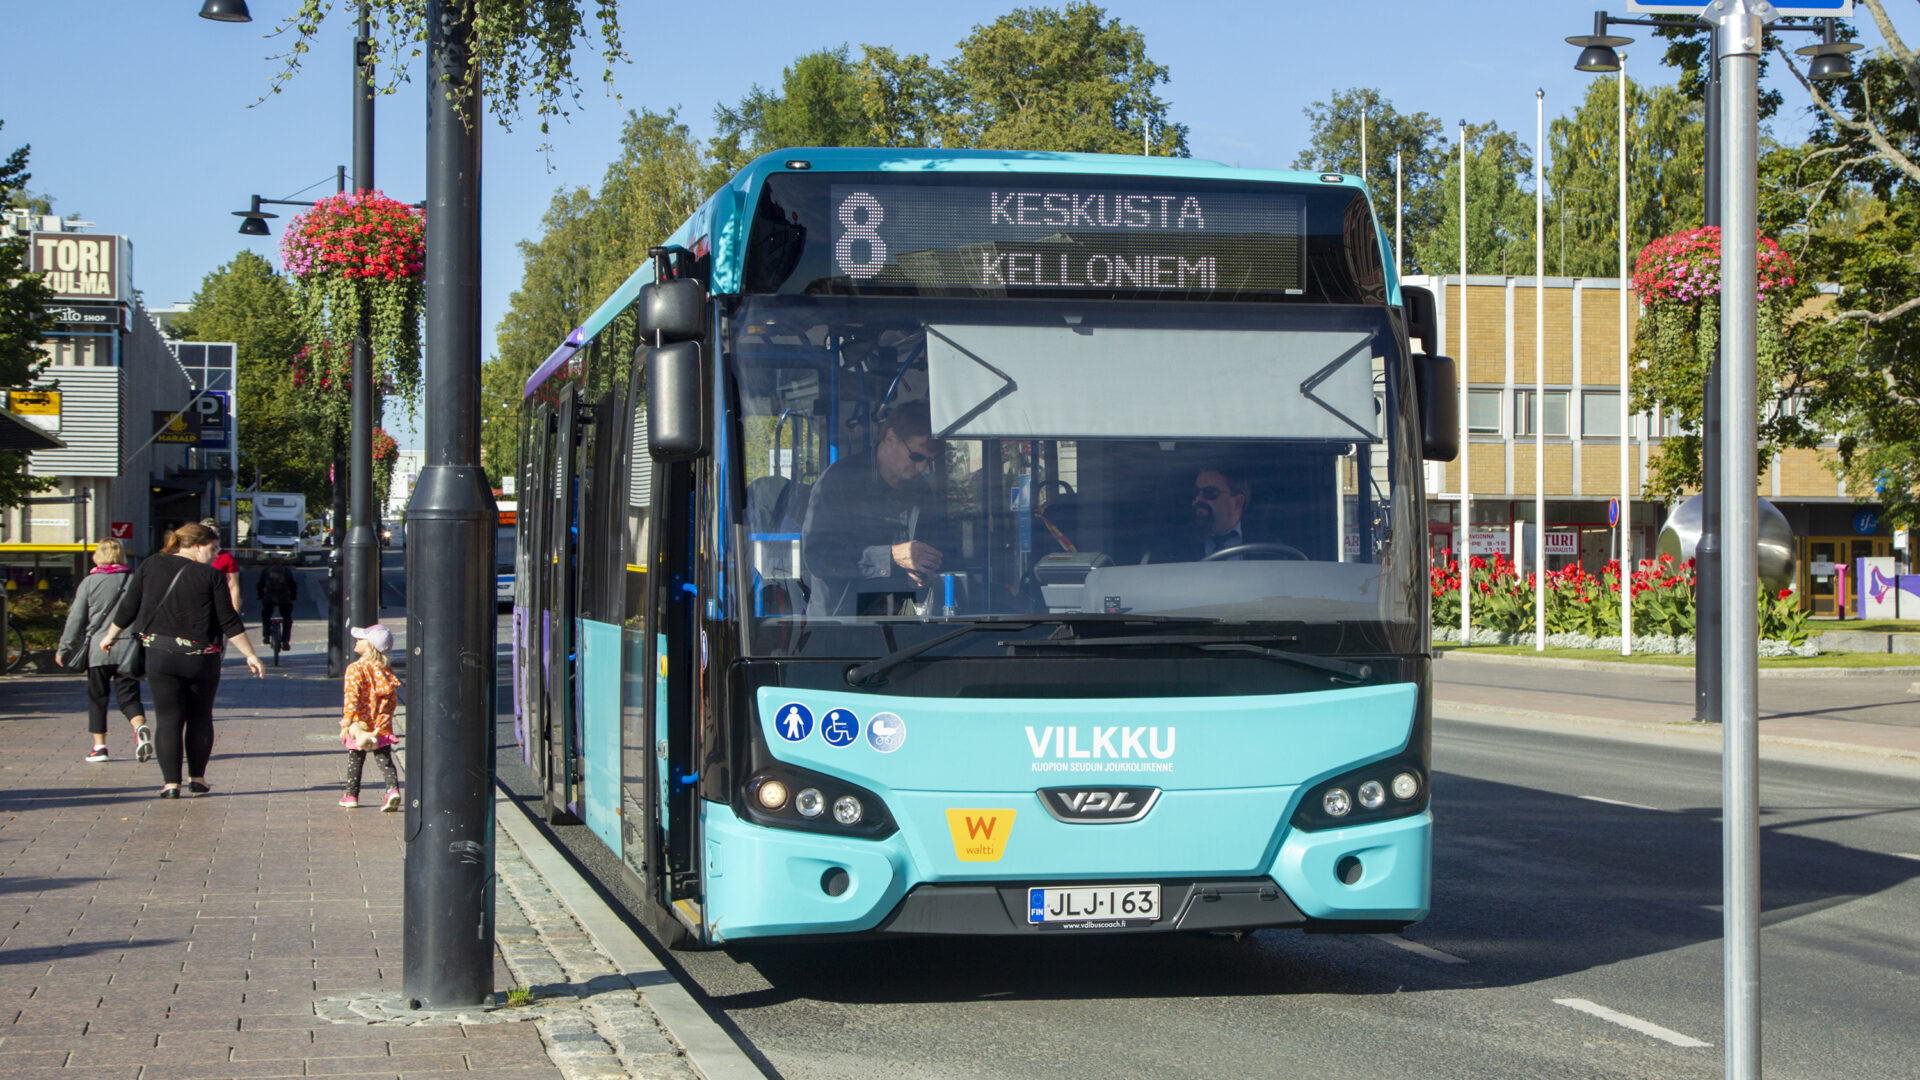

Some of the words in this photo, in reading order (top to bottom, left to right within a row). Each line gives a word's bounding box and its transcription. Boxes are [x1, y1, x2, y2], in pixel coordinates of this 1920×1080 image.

[991, 191, 1205, 229] KESKUSTA
[835, 191, 887, 279] 8
[37, 238, 110, 272] TORI
[982, 252, 1216, 288] KELLONIEMI
[196, 397, 219, 424] P
[1544, 534, 1574, 546] TURI
[1024, 726, 1176, 759] VILKKU
[1032, 762, 1068, 771] KUOPION
[1070, 762, 1103, 772] SEUDUN
[1104, 762, 1174, 772] JOUKKOLIIKENNE
[1057, 791, 1137, 812] VDL
[965, 816, 997, 840] W
[966, 844, 994, 855] waltti
[1031, 908, 1043, 916] FIN
[1050, 890, 1153, 916] JLJ-163
[1063, 920, 1126, 929] www.vdlbuscoach.fi
